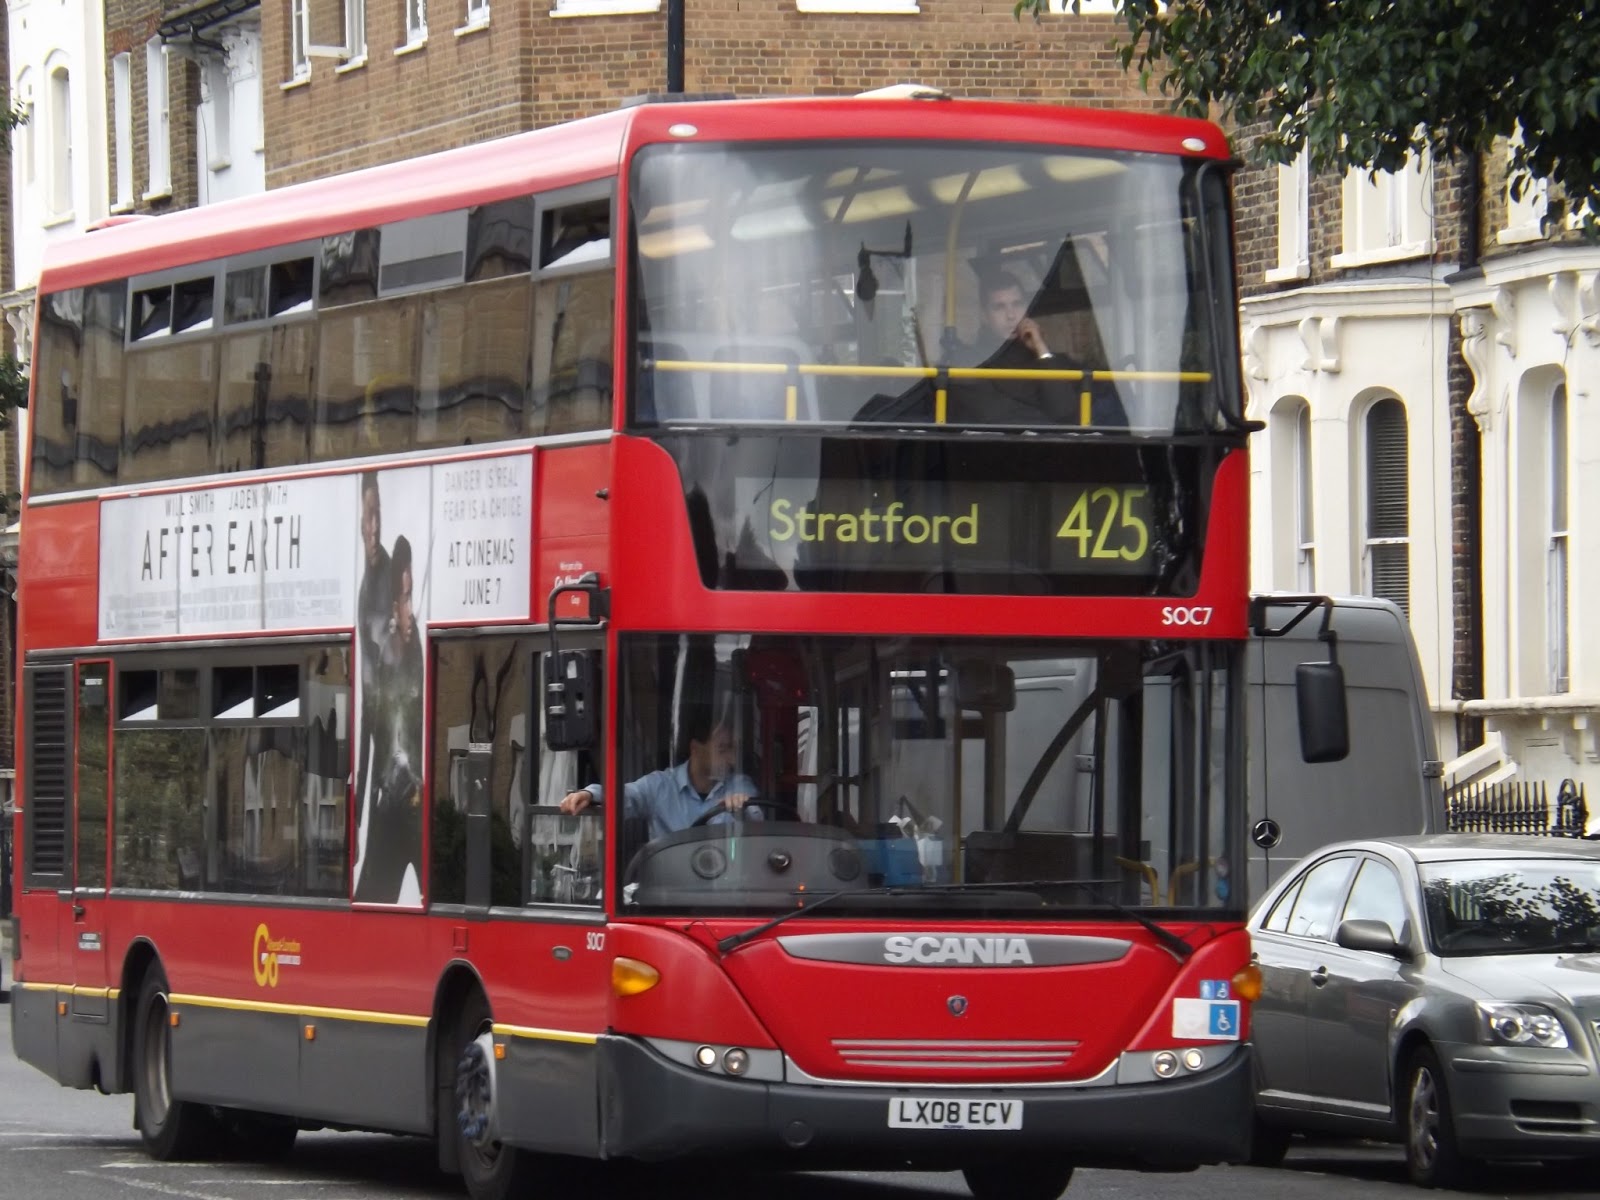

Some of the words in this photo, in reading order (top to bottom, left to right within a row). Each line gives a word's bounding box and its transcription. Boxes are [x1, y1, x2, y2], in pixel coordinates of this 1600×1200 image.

[189, 492, 215, 515] SMITH
[228, 488, 258, 511] JADEN
[769, 498, 979, 545] Stratford
[1056, 487, 1150, 562] 425
[141, 523, 214, 582] AFTER
[227, 514, 302, 575] EARTH
[448, 541, 463, 568] AT
[465, 537, 516, 567] CINEMAS
[462, 578, 492, 606] JUNE
[495, 577, 502, 605] 7
[1161, 606, 1214, 627] SOC7
[883, 936, 1034, 965] SCANIA
[899, 1100, 962, 1125] LX08
[967, 1102, 1013, 1125] ECV
